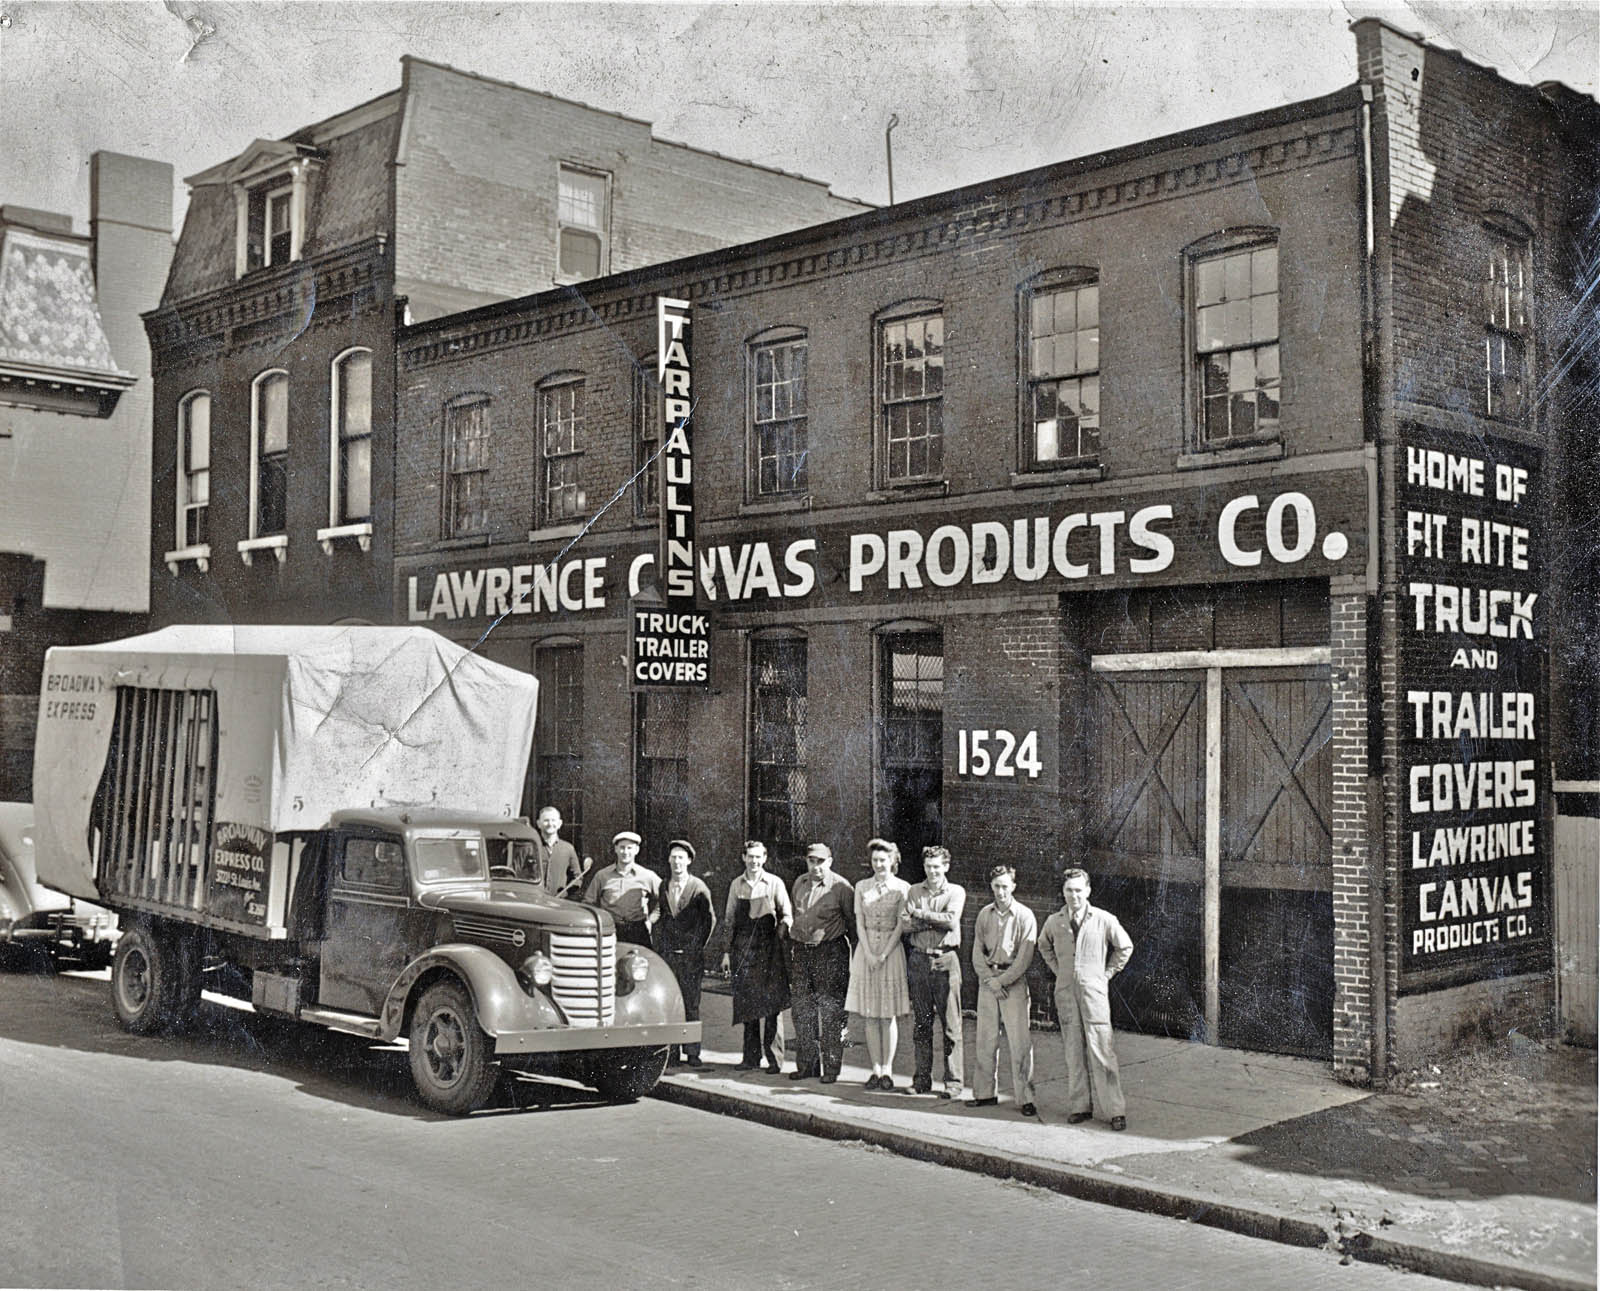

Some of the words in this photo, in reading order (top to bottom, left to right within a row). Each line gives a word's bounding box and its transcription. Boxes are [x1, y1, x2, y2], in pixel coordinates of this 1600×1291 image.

[664, 313, 693, 597] TARPAULINS
[1407, 446, 1484, 497] HOME
[1496, 464, 1528, 503] OF
[408, 557, 607, 621] LAWRENCE
[628, 538, 817, 600] CNVAS
[849, 505, 1174, 592] PRODUCTS
[1218, 492, 1348, 567] CO.
[1407, 511, 1447, 559] FIT
[1461, 517, 1529, 570] RITE
[1409, 583, 1538, 639] TRUCK
[636, 637, 709, 658] TRAILER
[636, 662, 707, 681] COVERS
[1450, 649, 1498, 670] AND
[47, 701, 96, 721] EXPRESS
[1408, 691, 1535, 740] TRAILER
[957, 729, 1043, 778] 1524
[293, 796, 304, 811] 5
[1410, 760, 1535, 813] COVERS
[215, 849, 250, 870] EXPRESS
[217, 824, 267, 851] BROADWAY
[1412, 820, 1535, 869] LAWRENCE
[1420, 872, 1532, 922] CANVAS
[1412, 917, 1499, 955] PRODUCTS
[1507, 914, 1532, 938] CO.
